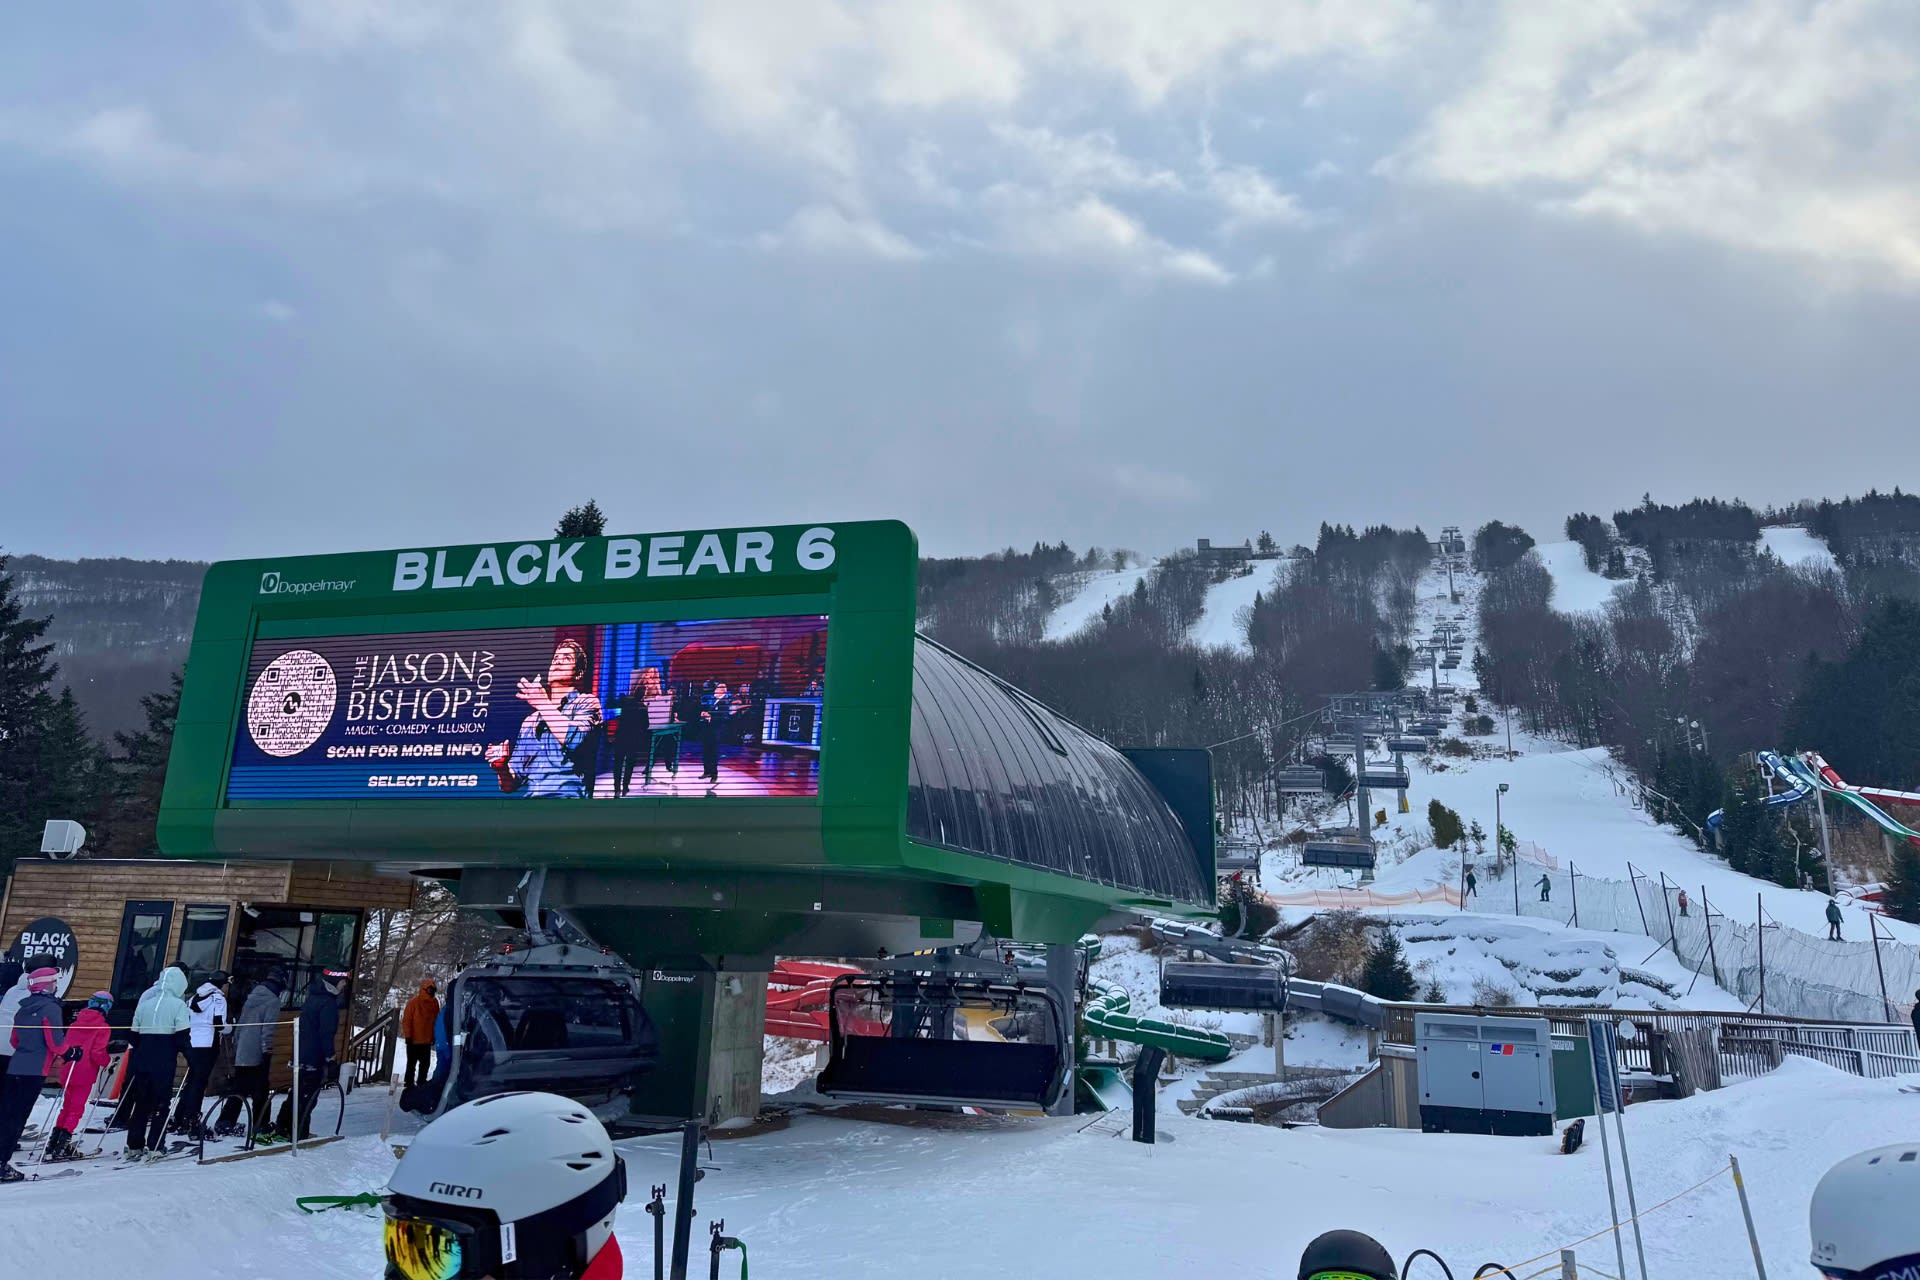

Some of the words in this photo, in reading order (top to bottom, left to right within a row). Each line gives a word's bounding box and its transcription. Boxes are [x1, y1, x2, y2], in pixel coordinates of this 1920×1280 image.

[392, 541, 586, 591] BLACK
[604, 531, 774, 580] BEAR
[796, 527, 837, 571] 6
[278, 579, 357, 595] Doppelmayr
[351, 655, 369, 689] THE
[365, 651, 477, 690] JASON
[472, 650, 496, 718] SHOW
[346, 687, 472, 721] BISHOP
[344, 725, 379, 736] MAGIC
[386, 723, 430, 735] COMEDY
[437, 722, 486, 734] ILLUSION
[326, 745, 366, 758] SCAN
[368, 744, 398, 758] FOR
[401, 744, 443, 757] MORE
[446, 743, 482, 757] INFO
[368, 775, 425, 787] SELECT
[428, 774, 478, 787] DATES
[21, 932, 70, 946] BLACK
[429, 1182, 483, 1200] GIRO
